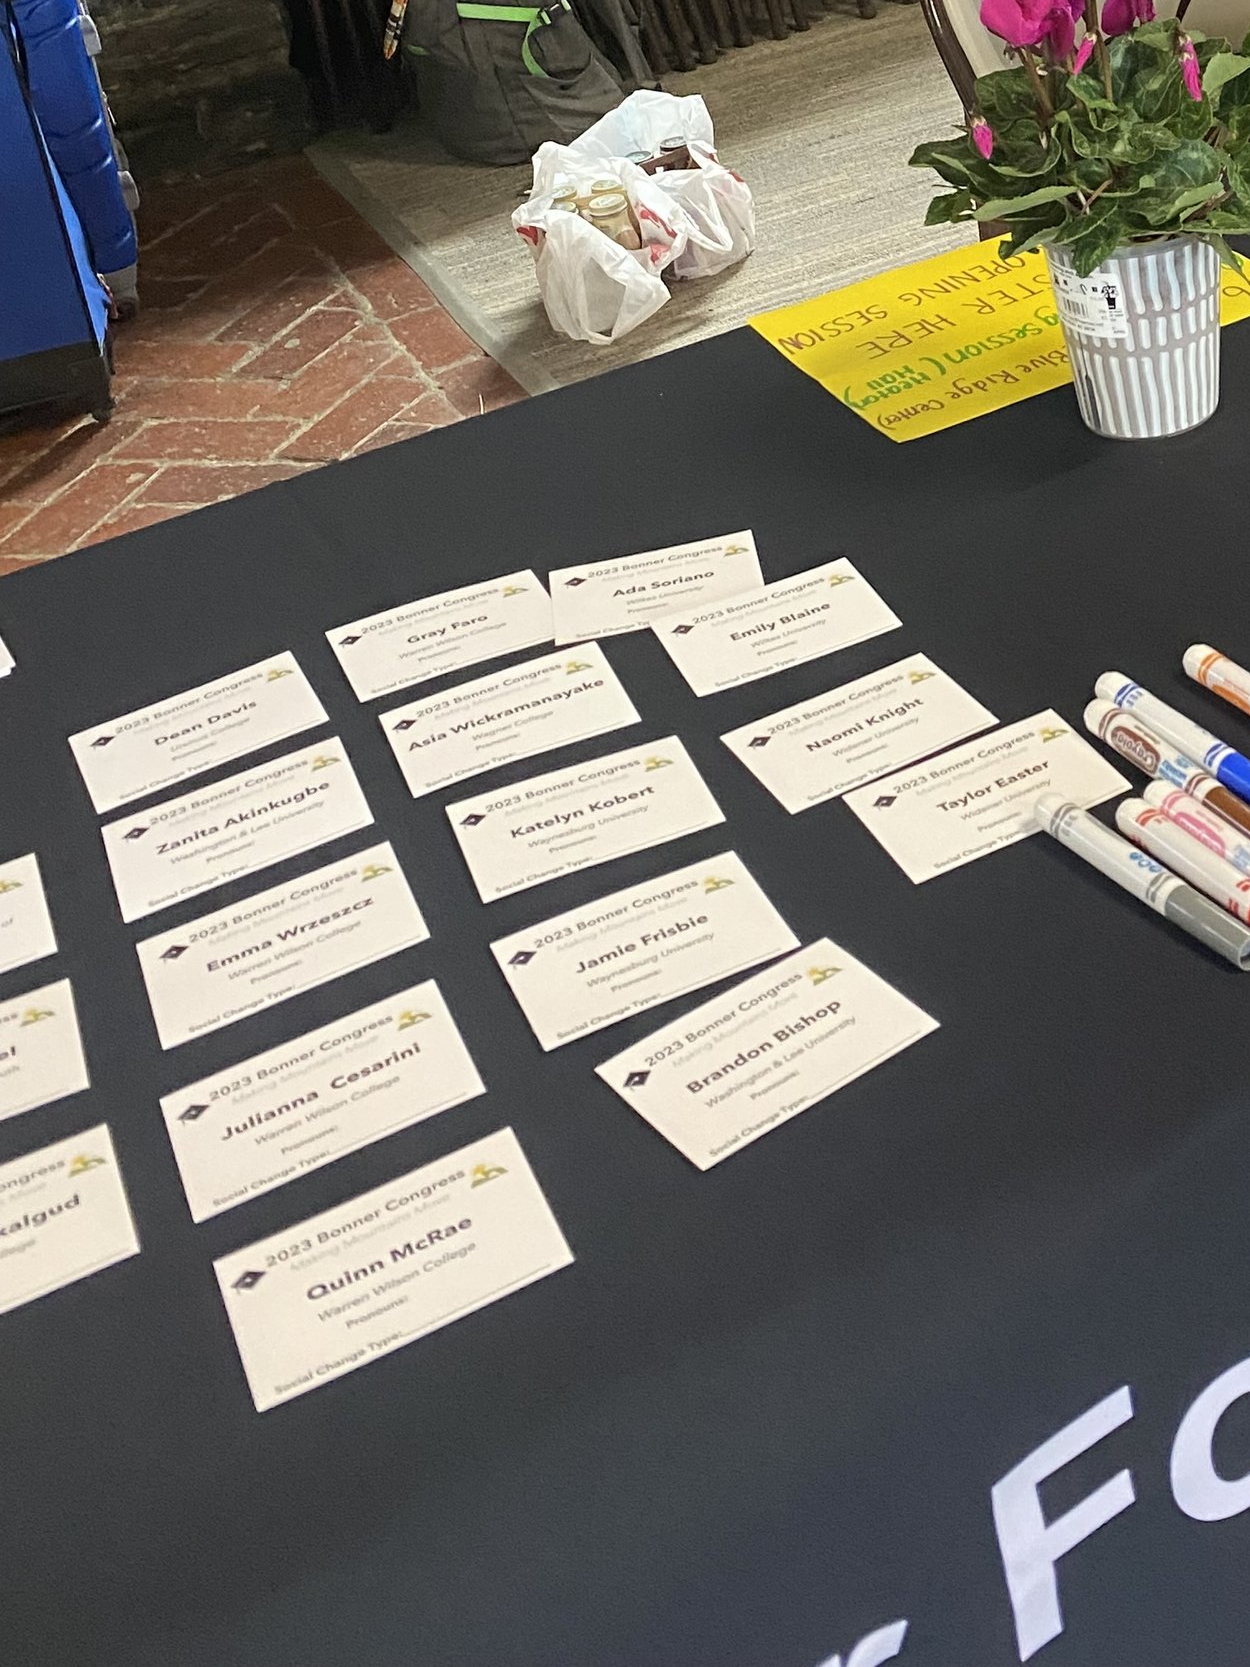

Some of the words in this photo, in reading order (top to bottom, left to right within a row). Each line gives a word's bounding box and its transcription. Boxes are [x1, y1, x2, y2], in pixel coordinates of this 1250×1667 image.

[898, 256, 1026, 306] OPENING
[778, 304, 888, 355] SESSION
[856, 314, 957, 360] HERE
[613, 586, 646, 597] Ada
[651, 570, 715, 589] Soriano
[407, 626, 446, 644] Gray
[451, 615, 488, 629] Faro
[730, 621, 776, 642] Emily
[780, 602, 831, 624] Blaine
[155, 723, 202, 746] Dean
[208, 701, 257, 723] Davis
[409, 732, 447, 751] Asia
[450, 678, 605, 734] Wickramanayake
[806, 723, 863, 752] Naomi
[866, 698, 924, 727] Knight
[156, 825, 219, 855] Zanita
[224, 782, 330, 828] Akinkugbe
[511, 809, 585, 838] Katelyn
[589, 786, 655, 814] Kobert
[937, 784, 993, 813] Taylor
[997, 760, 1050, 788] Easter
[189, 921, 228, 943] 2023
[232, 898, 287, 924] Bonner
[290, 868, 358, 901] Congress
[206, 942, 273, 972] Emma
[276, 897, 374, 942] Wrzeszcz
[534, 927, 573, 949] 2023
[577, 906, 629, 932] Bonner
[632, 880, 699, 909] Congress
[575, 942, 637, 974] Jamie
[641, 913, 709, 946] Frisbie
[644, 1041, 685, 1068] 2023
[686, 1010, 737, 1044] Bonner
[738, 973, 803, 1014] Congress
[686, 1040, 775, 1094] Brandon
[773, 999, 843, 1043] Bishop
[209, 1077, 253, 1102] 2023
[257, 1048, 317, 1081] Bonner
[320, 1015, 393, 1051] Congress
[221, 1090, 319, 1141] Julianna
[329, 1041, 421, 1090] Cesarini
[705, 1067, 773, 1109] Washington
[773, 1059, 783, 1070] &
[784, 1047, 805, 1062] Lee
[805, 1015, 857, 1049] University
[266, 1240, 313, 1268] 2023
[317, 1208, 382, 1244] Bonner
[385, 1168, 466, 1211] Congress
[306, 1257, 386, 1301] Quinn
[389, 1216, 473, 1263] McRae
[318, 1286, 371, 1322] Warren
[373, 1264, 421, 1297] Wilson
[422, 1241, 477, 1275] College
